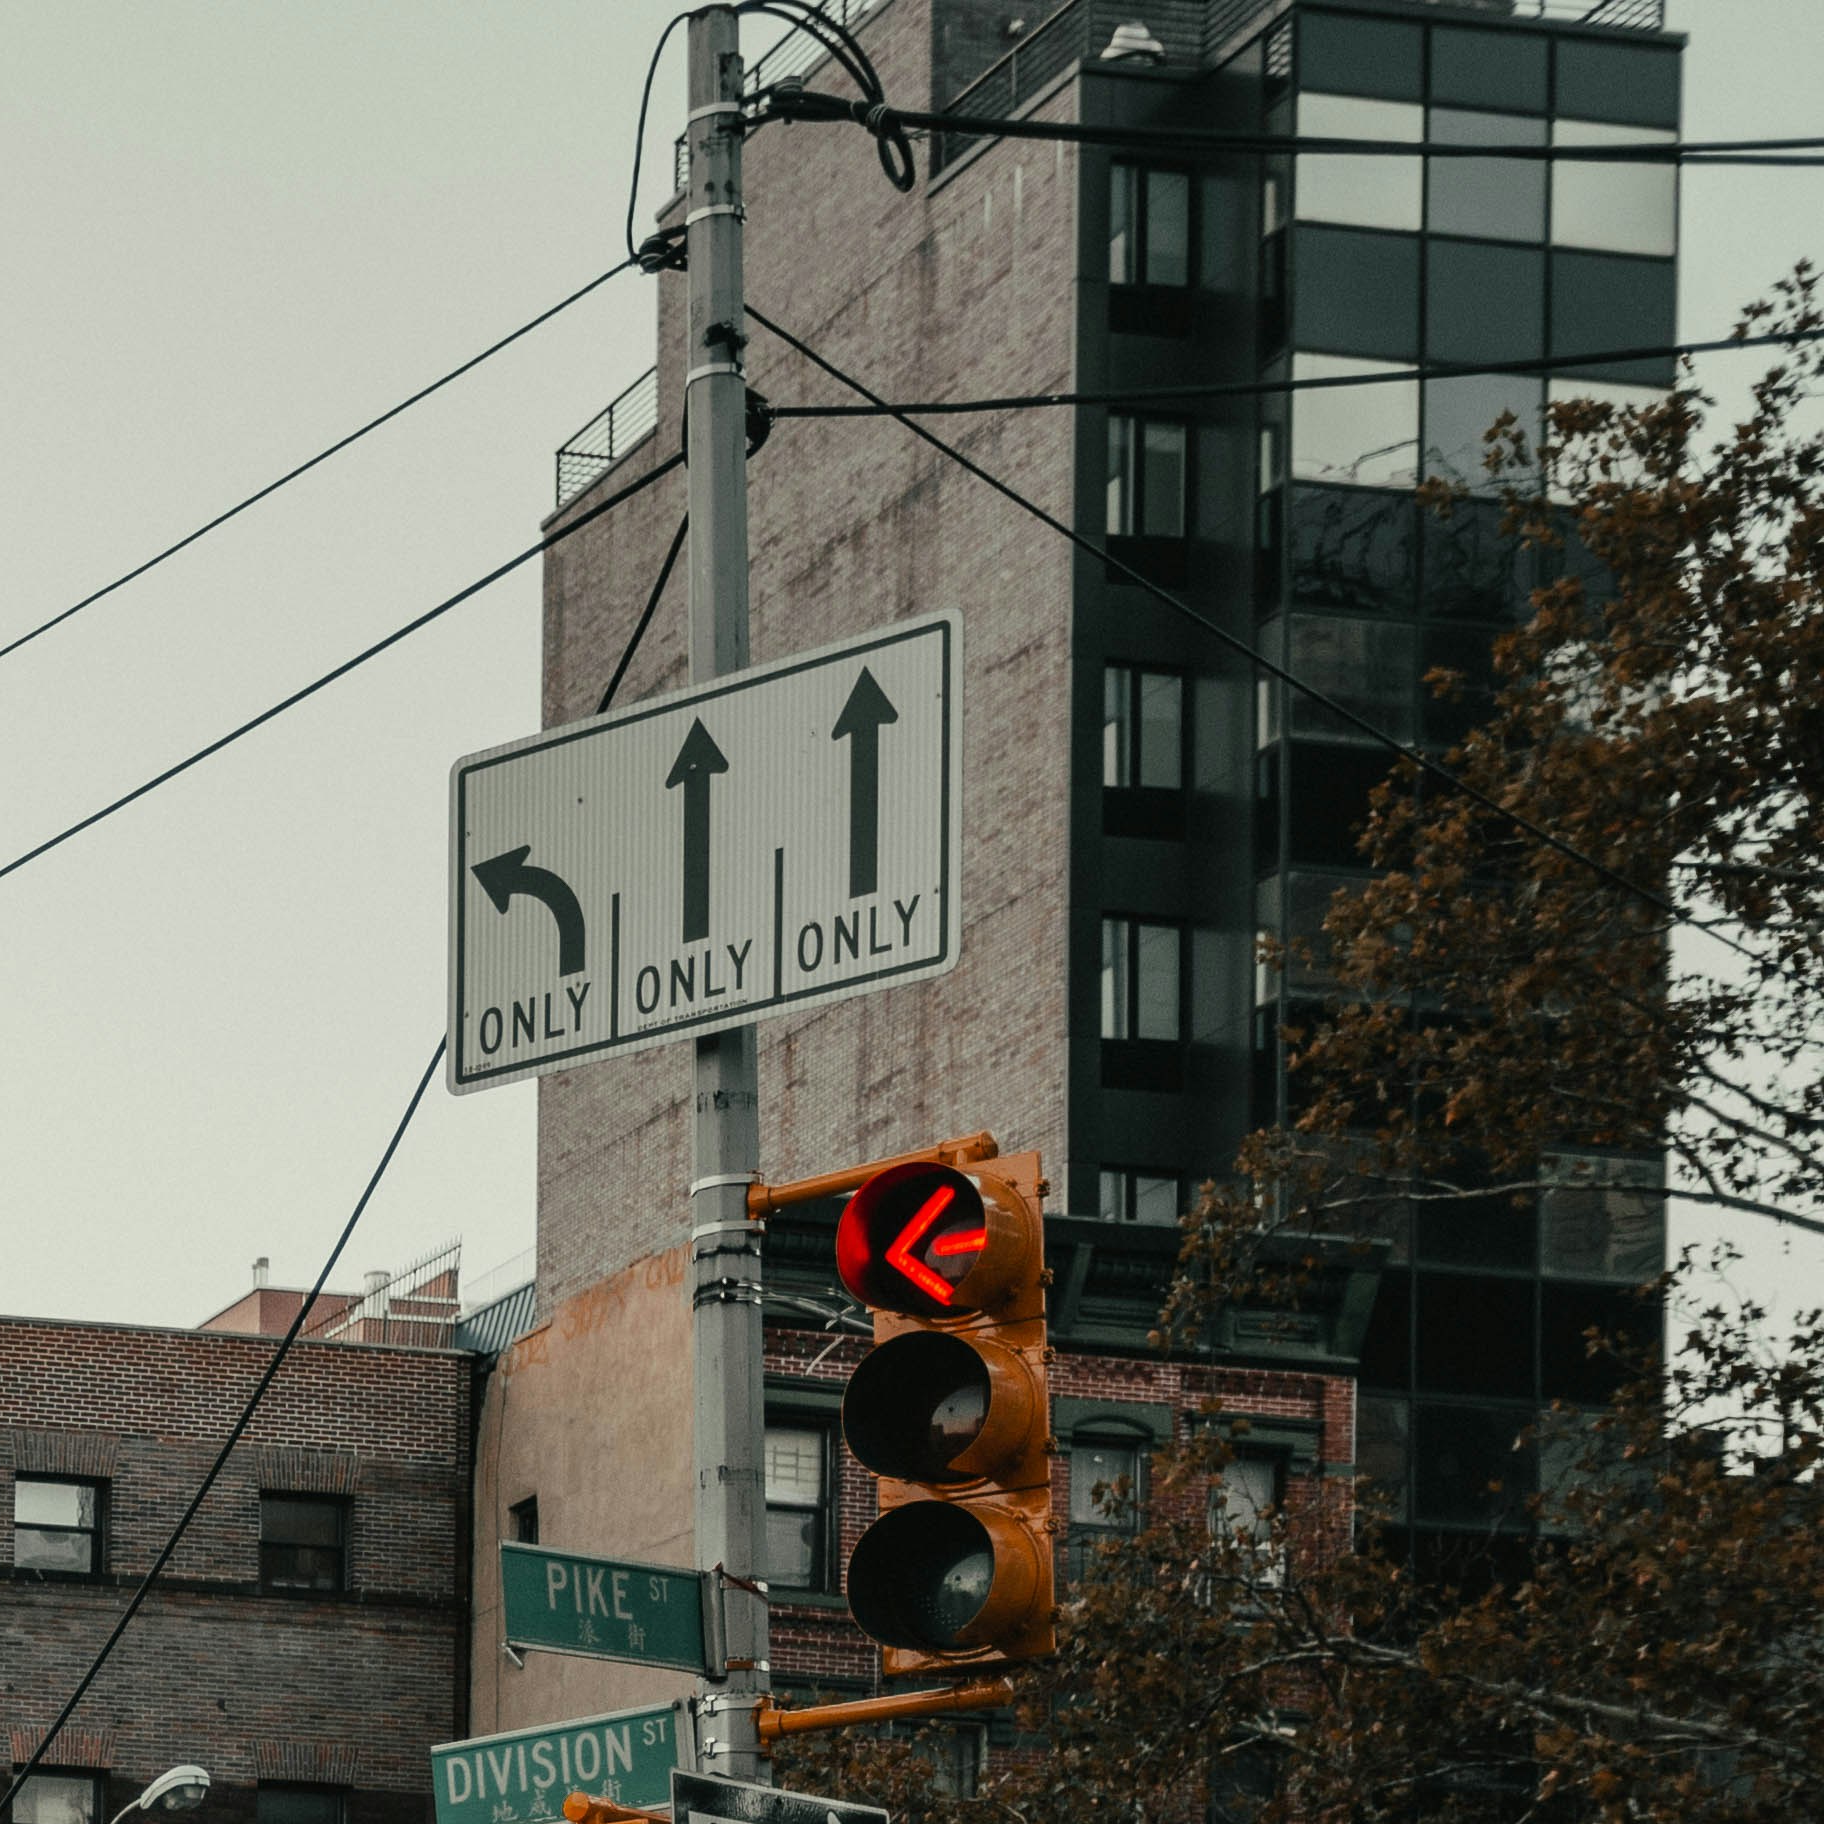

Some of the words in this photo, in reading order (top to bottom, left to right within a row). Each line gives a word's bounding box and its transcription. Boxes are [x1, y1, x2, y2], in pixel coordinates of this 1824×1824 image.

[797, 894, 921, 972] ONLY
[636, 939, 752, 1015] ONLY
[480, 981, 591, 1055] ONLY
[547, 1561, 633, 1620] PIKE
[649, 1576, 669, 1603] ST
[447, 1724, 633, 1804] DIVISION
[642, 1718, 667, 1746] ST
